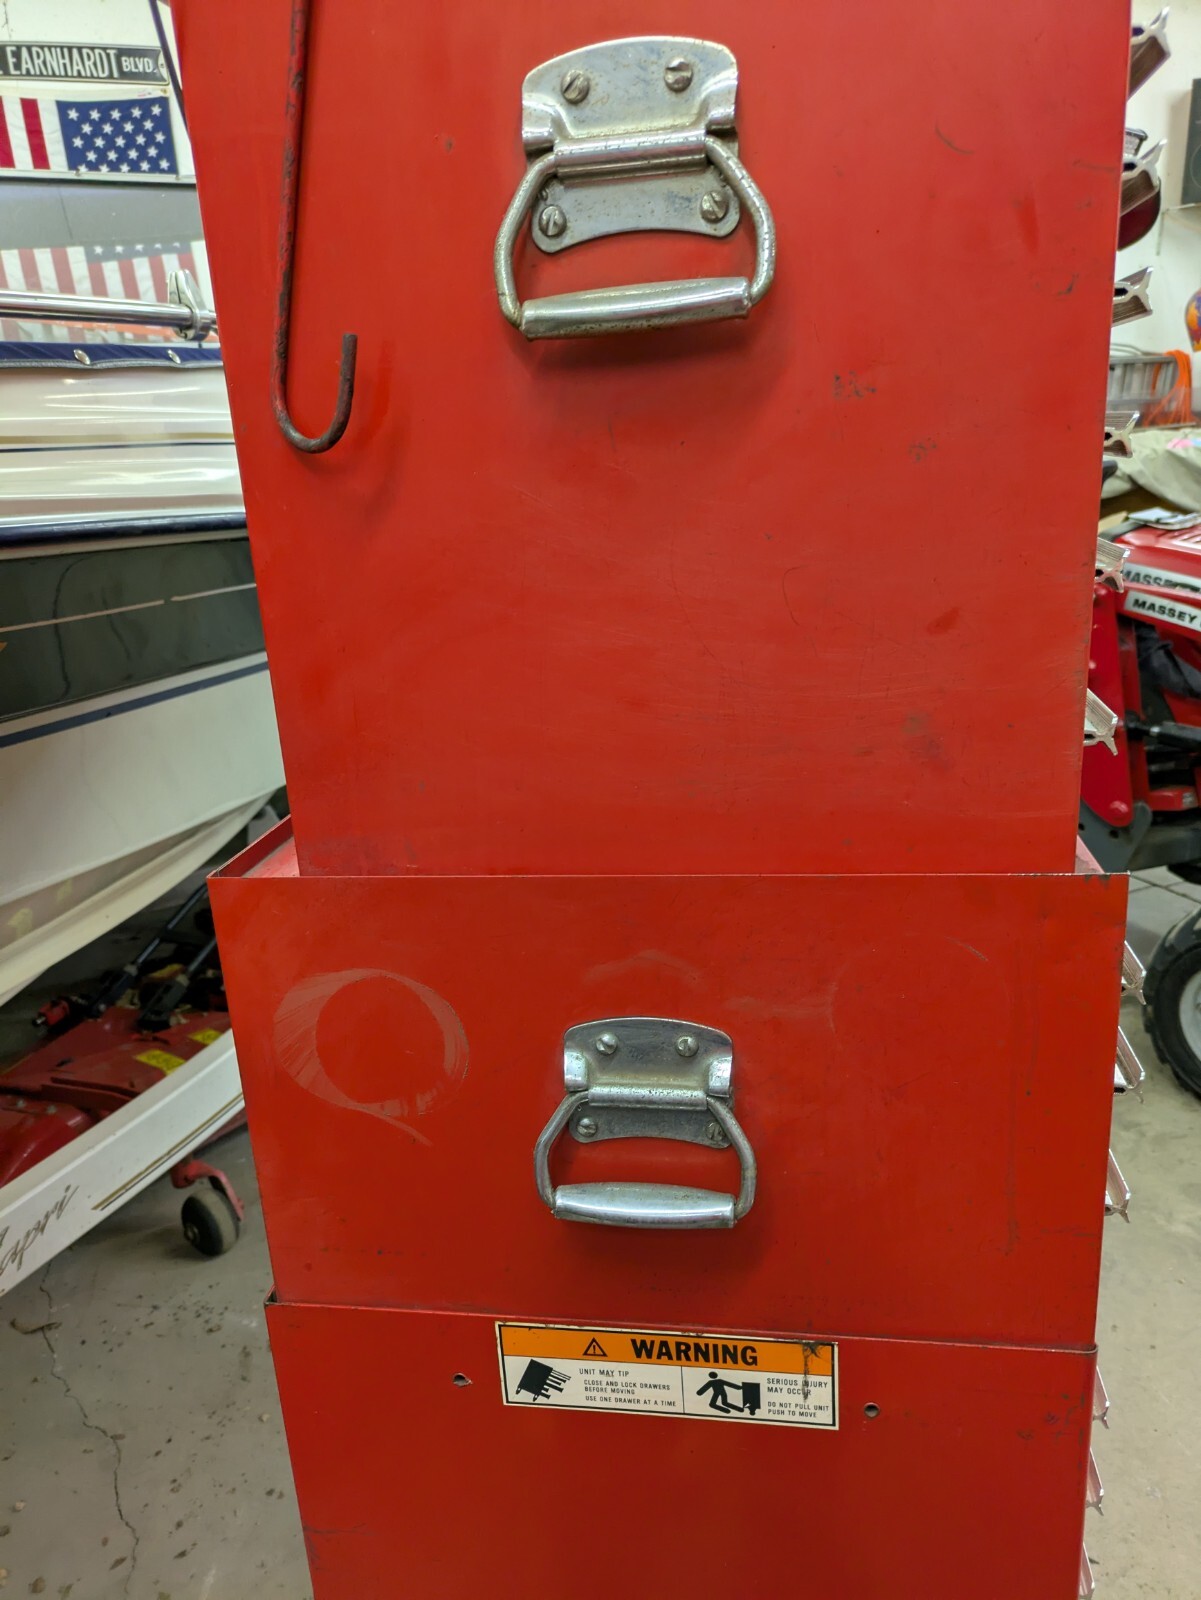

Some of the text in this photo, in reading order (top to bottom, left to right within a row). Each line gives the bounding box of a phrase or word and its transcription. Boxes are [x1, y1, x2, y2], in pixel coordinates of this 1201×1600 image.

[5, 46, 157, 78] EARNHARDT BLVD.
[1132, 598, 1198, 624] MASSEY
[630, 1338, 758, 1367] WARNING
[767, 1377, 798, 1386] SERIOUS
[611, 1387, 635, 1395] MOVING
[639, 1382, 671, 1391] DRAWERS
[767, 1386, 783, 1394] MAY
